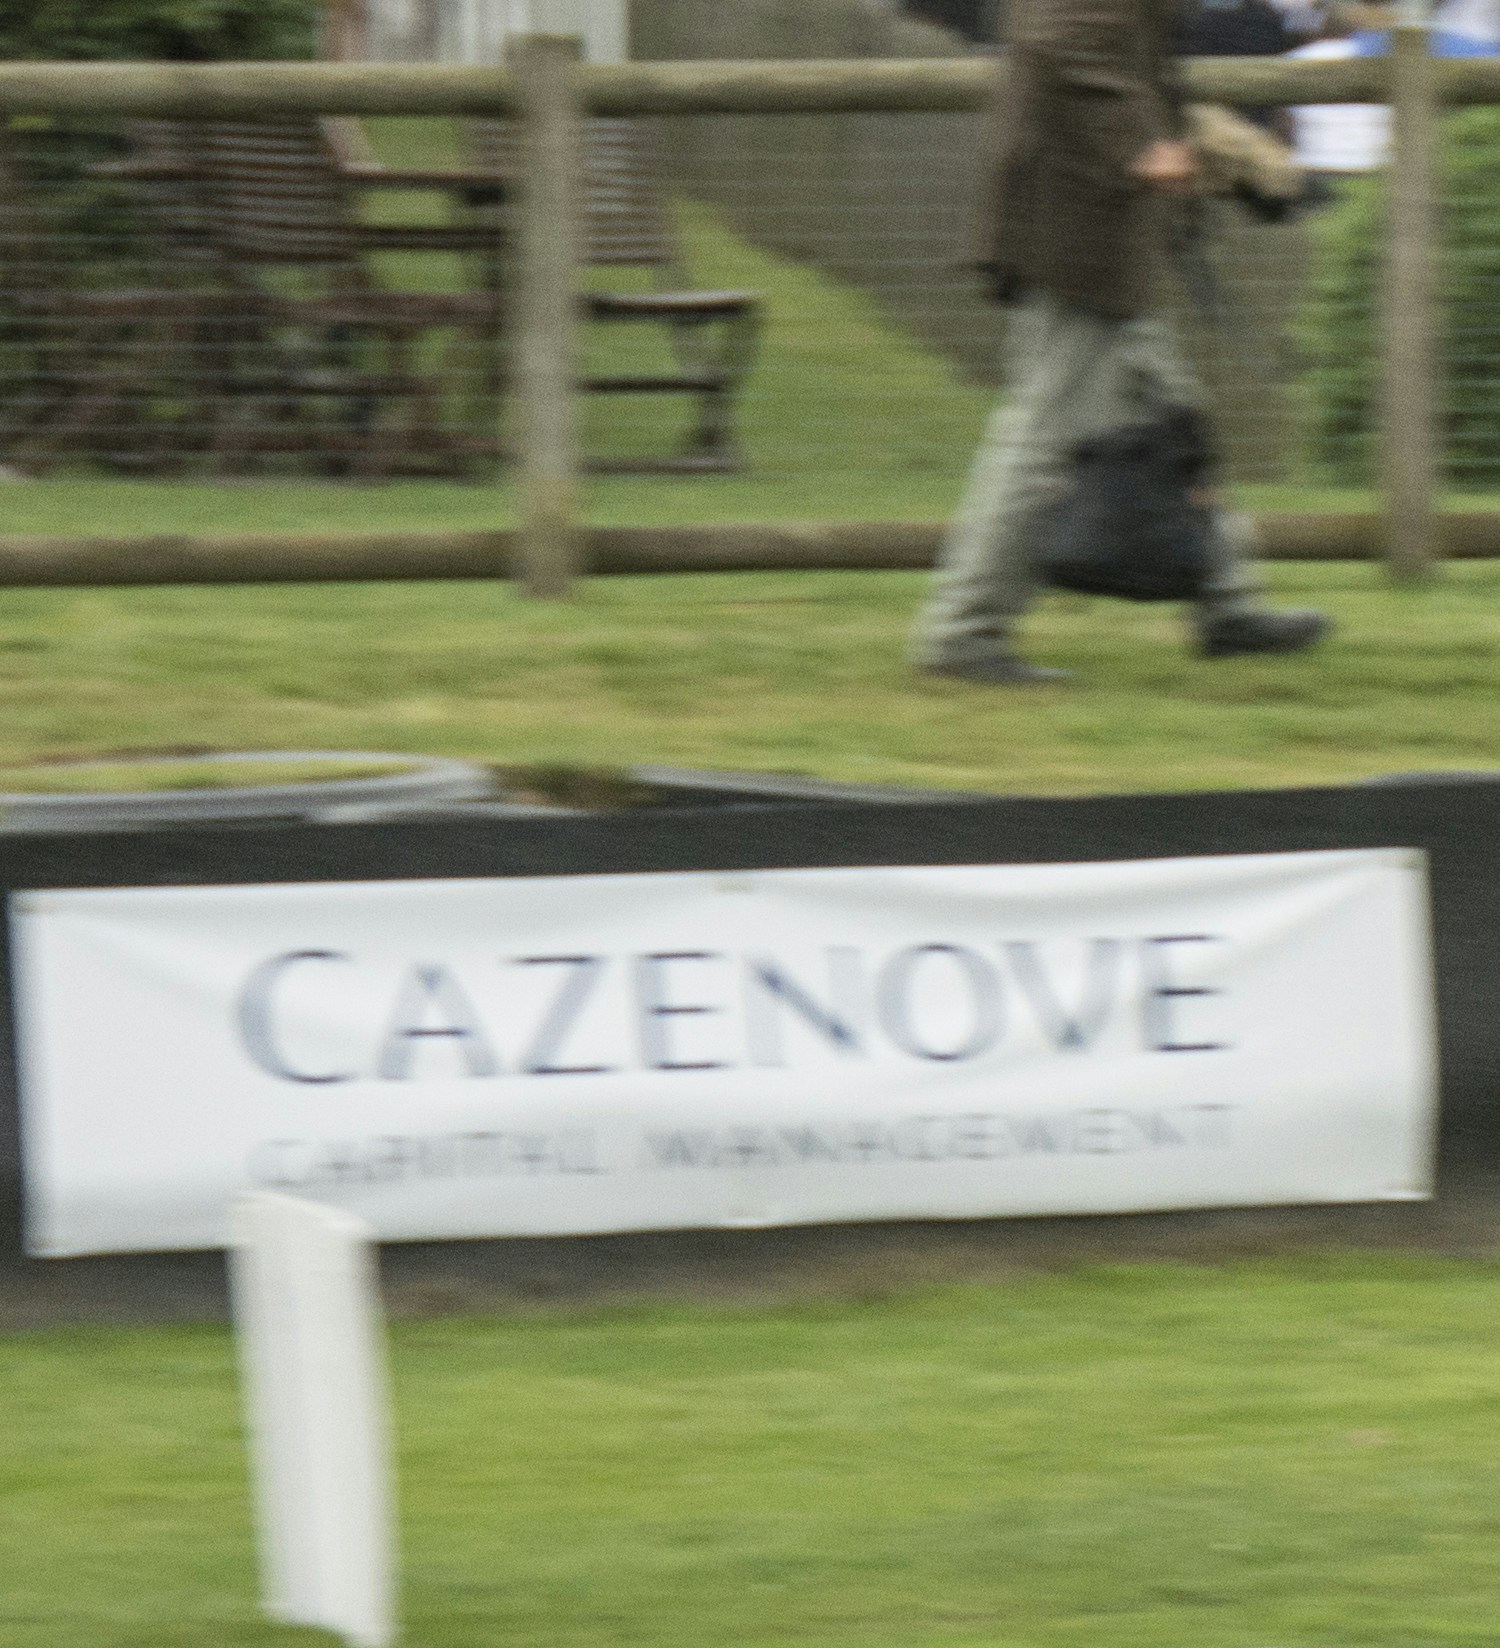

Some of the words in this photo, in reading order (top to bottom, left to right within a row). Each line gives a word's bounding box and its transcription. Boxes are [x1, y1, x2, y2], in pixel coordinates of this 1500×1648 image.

[234, 930, 1236, 1086] CAZENOVE
[243, 1130, 610, 1188] CAPITAL
[640, 1102, 1238, 1170] MANAGEMENT
